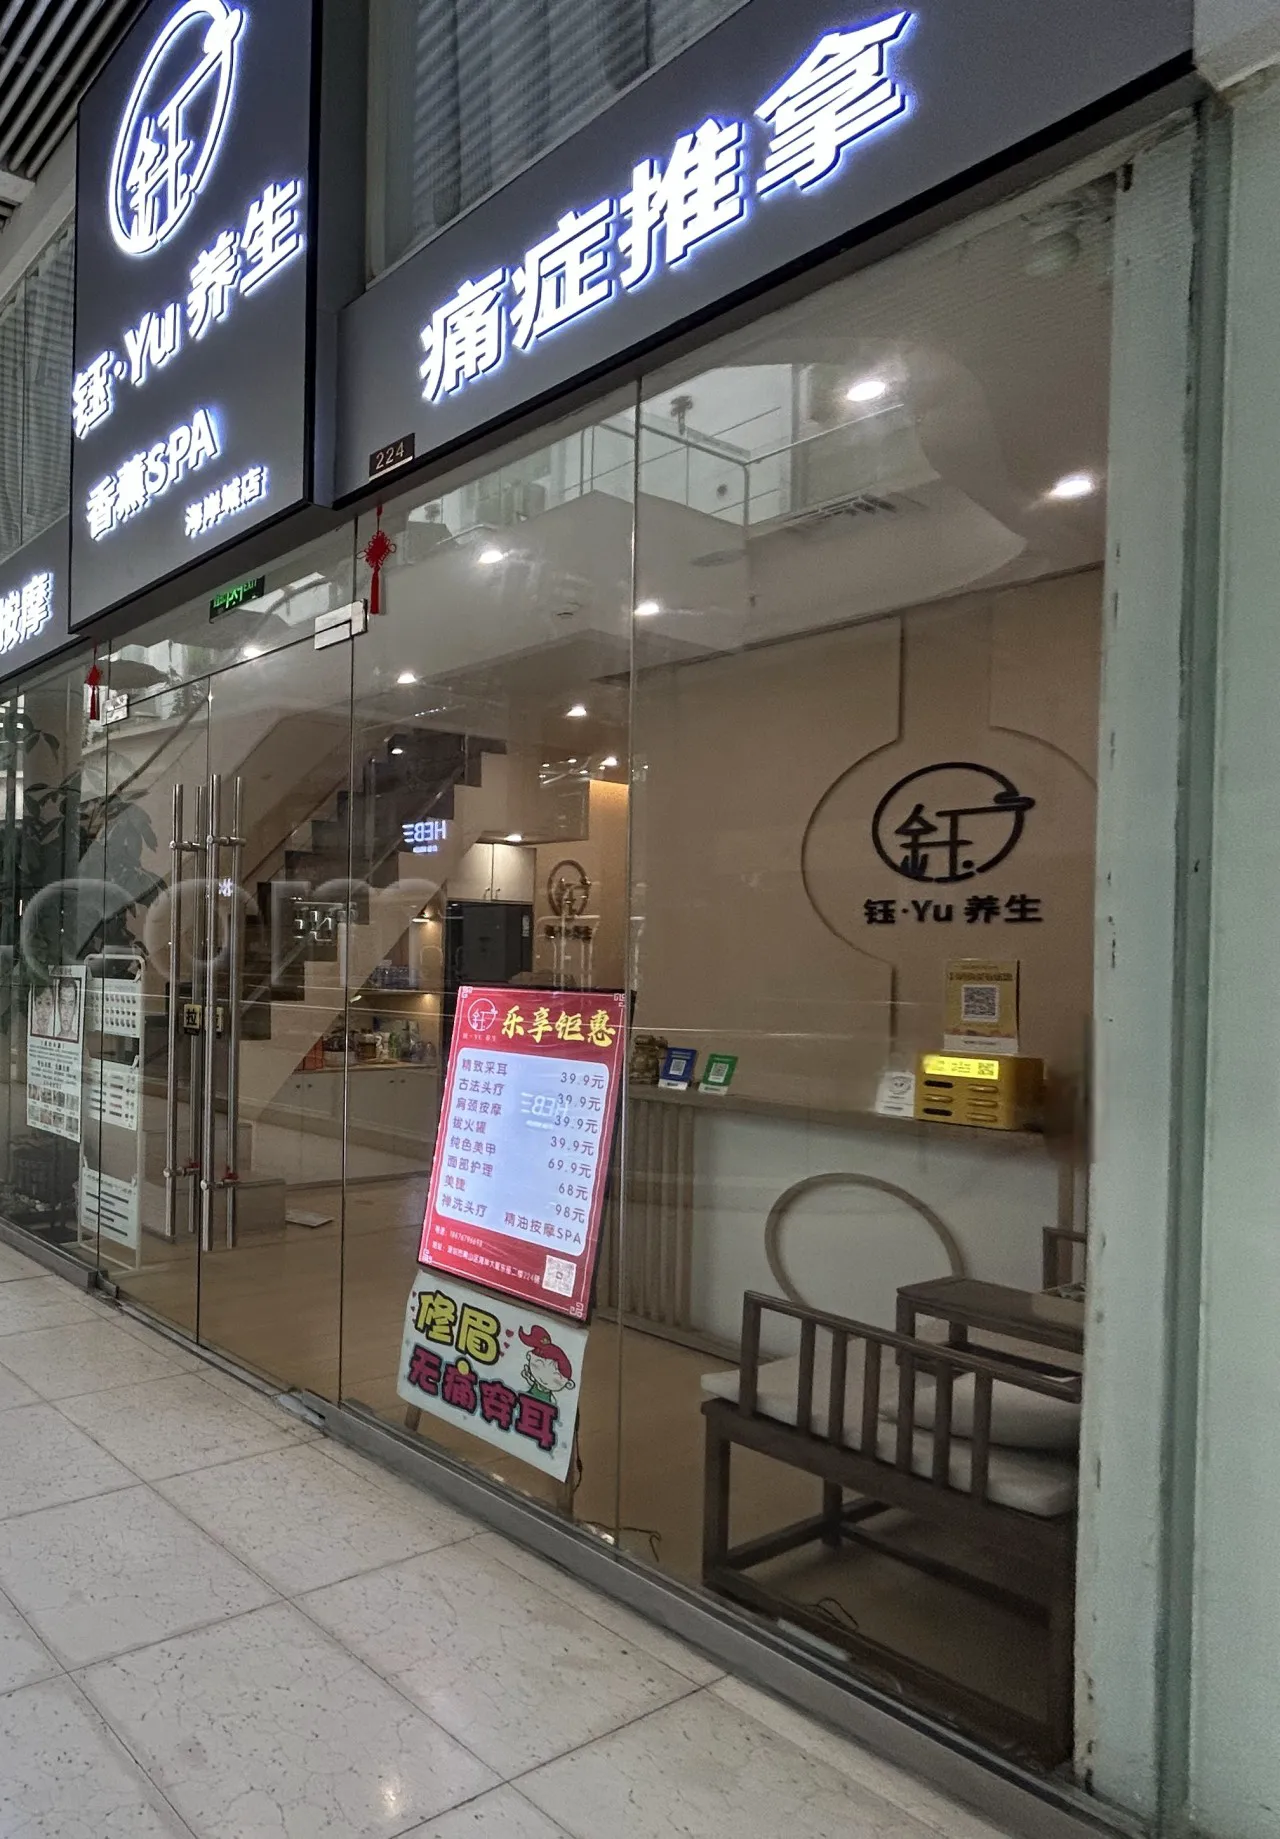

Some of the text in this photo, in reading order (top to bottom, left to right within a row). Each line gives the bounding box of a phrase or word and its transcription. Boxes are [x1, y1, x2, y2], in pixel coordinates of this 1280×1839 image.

[419, 9, 913, 402] 痛症推拿
[186, 178, 306, 342] 养生
[375, 441, 406, 469] 224
[964, 894, 1044, 924] 养生
[185, 1008, 197, 1026] 拉
[501, 1004, 616, 1047] 乐享钜惠
[461, 1058, 508, 1076] 精致采耳
[458, 1078, 505, 1097] 古法头疗
[455, 1097, 502, 1117] 肩颈按摩
[449, 1135, 496, 1156] 纯色美甲
[446, 1154, 588, 1201] 面部护理 68元
[504, 1211, 582, 1246] 精油按摩SPA
[555, 1204, 585, 1224] 98元
[415, 1289, 501, 1366] 修眉
[406, 1344, 559, 1451] 无痛穿耳
